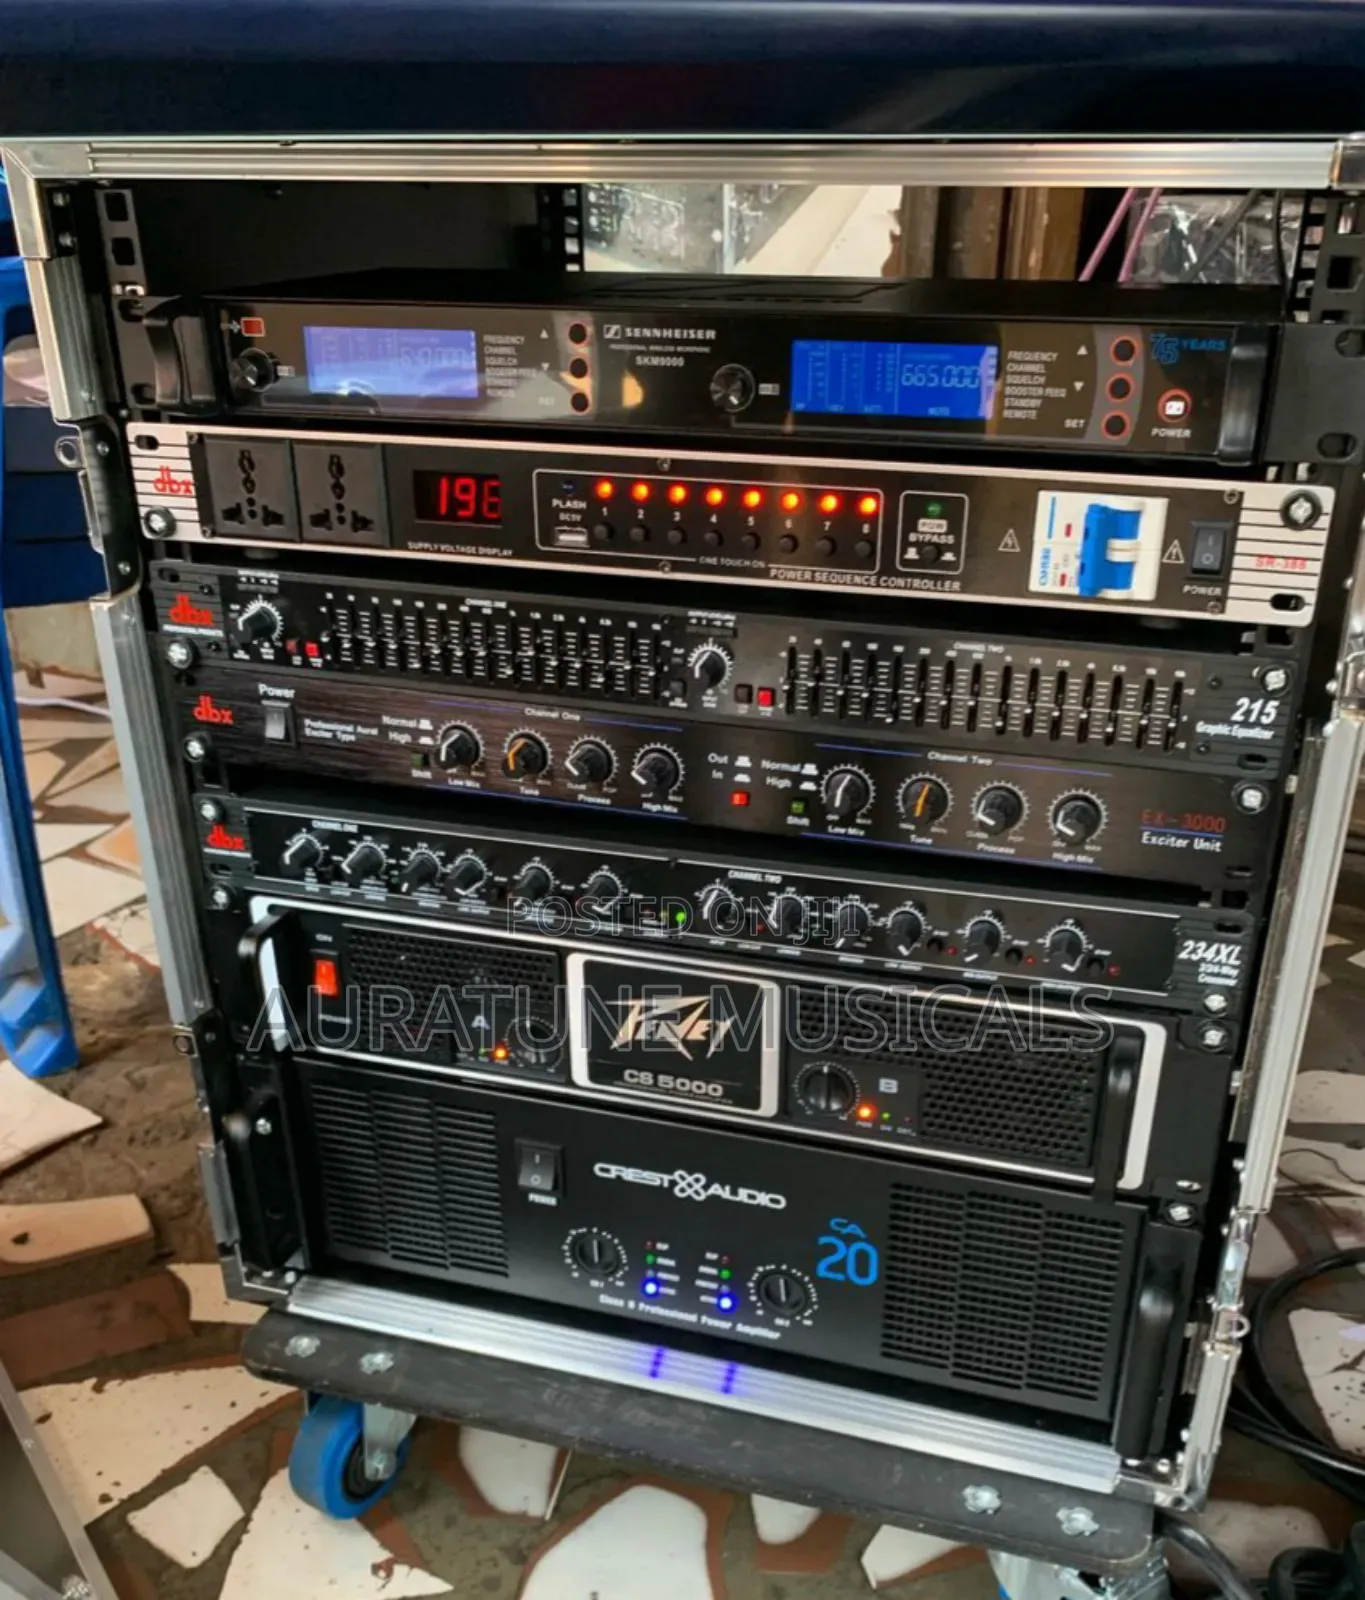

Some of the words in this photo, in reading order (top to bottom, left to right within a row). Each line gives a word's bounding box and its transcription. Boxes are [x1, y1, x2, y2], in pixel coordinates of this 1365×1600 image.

[483, 334, 525, 345] FREQUENCY
[624, 327, 717, 340] SENNHEISER
[1182, 338, 1226, 351] YEARS
[1007, 350, 1059, 362] FREQUENCY
[1006, 362, 1046, 374] CHANNEL
[1063, 418, 1085, 429] SET
[1151, 427, 1192, 438] POWER
[153, 465, 193, 494] dbx
[636, 508, 645, 520] 2
[673, 511, 682, 522] 3
[709, 513, 718, 524] 4
[784, 518, 794, 529] 6
[822, 520, 832, 532] 7
[908, 532, 956, 545] BYPASS
[407, 541, 439, 551] SUPPLY
[440, 544, 478, 554] VOLTAGE
[479, 546, 514, 557] DISPLAY
[720, 557, 748, 567] TOUCH
[769, 568, 812, 582] POWER
[814, 571, 877, 586] SEQUENCE
[879, 575, 962, 592] CONTROLLER
[1182, 584, 1223, 596] POWER
[258, 683, 296, 699] Power
[193, 694, 234, 725] dbx
[524, 707, 559, 719] Channel
[561, 711, 581, 721] One
[1230, 696, 1281, 725] 215
[382, 715, 417, 728] Normal
[388, 730, 412, 745] High
[707, 752, 729, 764] Out
[927, 751, 969, 763] Channel
[971, 754, 994, 766] Two
[760, 758, 801, 773] Normal
[711, 769, 724, 779] In
[447, 777, 464, 786] Low
[765, 775, 792, 789] High
[642, 801, 662, 812] High
[206, 823, 246, 851] dbx
[827, 824, 846, 834] Low
[847, 827, 866, 836] Mix
[1140, 830, 1191, 849] Exciter
[1192, 837, 1224, 853] Unit
[727, 869, 763, 882] CHANNEL
[764, 874, 783, 884] TWO
[1177, 939, 1243, 965] 234XL
[470, 1014, 491, 1030] A
[604, 995, 737, 1062] PEAVEY
[623, 1067, 655, 1086] CS
[657, 1073, 724, 1097] 5000
[878, 1077, 899, 1094] B
[593, 1162, 675, 1189] CREST
[705, 1182, 788, 1210] AUDIO
[829, 1217, 867, 1239] CA
[815, 1235, 880, 1286] 20
[638, 1302, 699, 1323] Professional
[700, 1314, 733, 1330] Power
